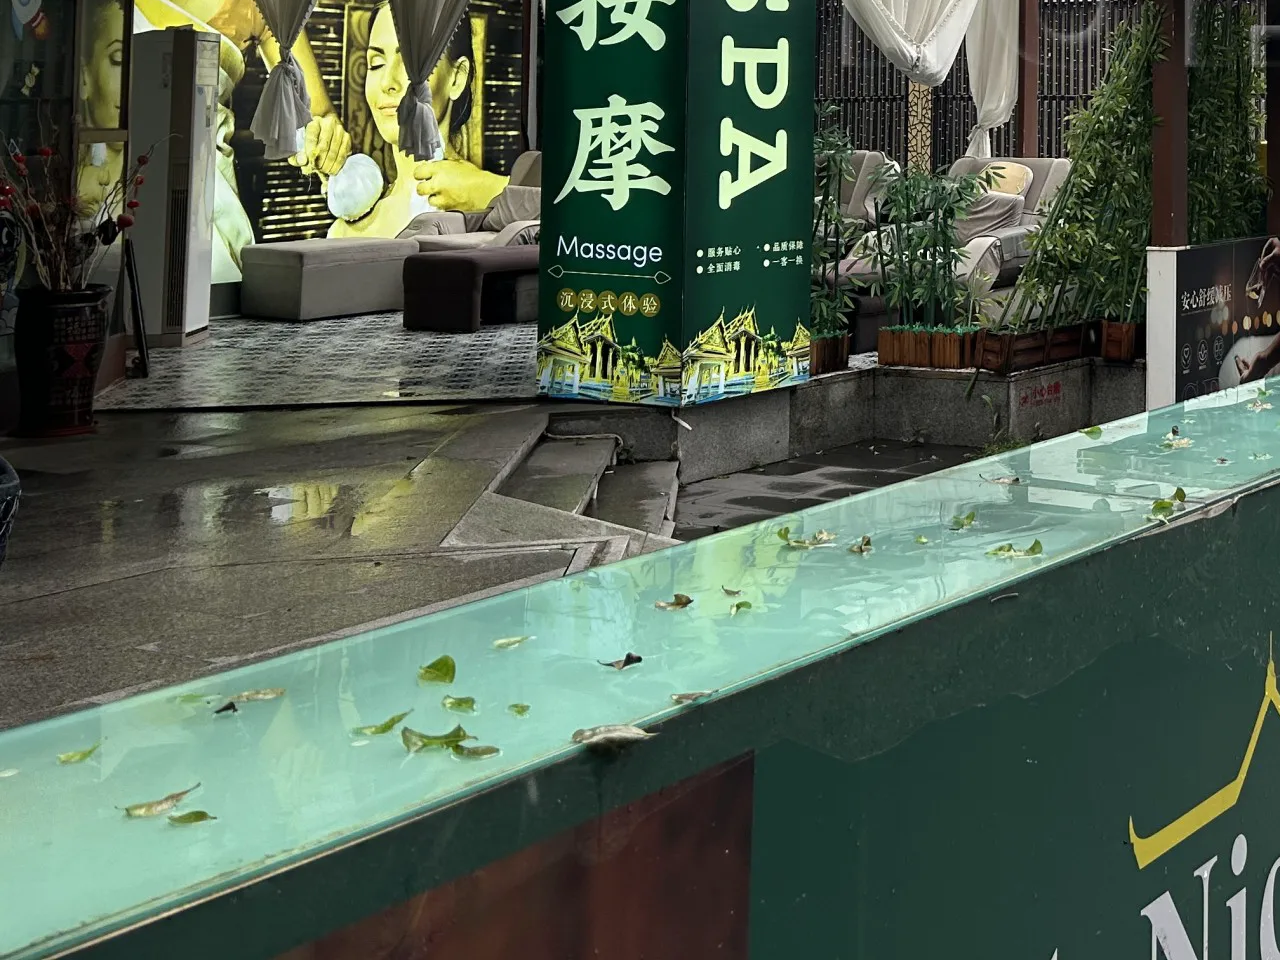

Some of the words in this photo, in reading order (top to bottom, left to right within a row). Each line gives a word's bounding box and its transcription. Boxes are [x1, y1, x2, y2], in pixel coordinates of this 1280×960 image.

[556, 234, 663, 268] Massage
[707, 245, 741, 258] 服务贴心
[706, 260, 741, 274] 全面消毒
[560, 290, 658, 314] 沉浸式体验
